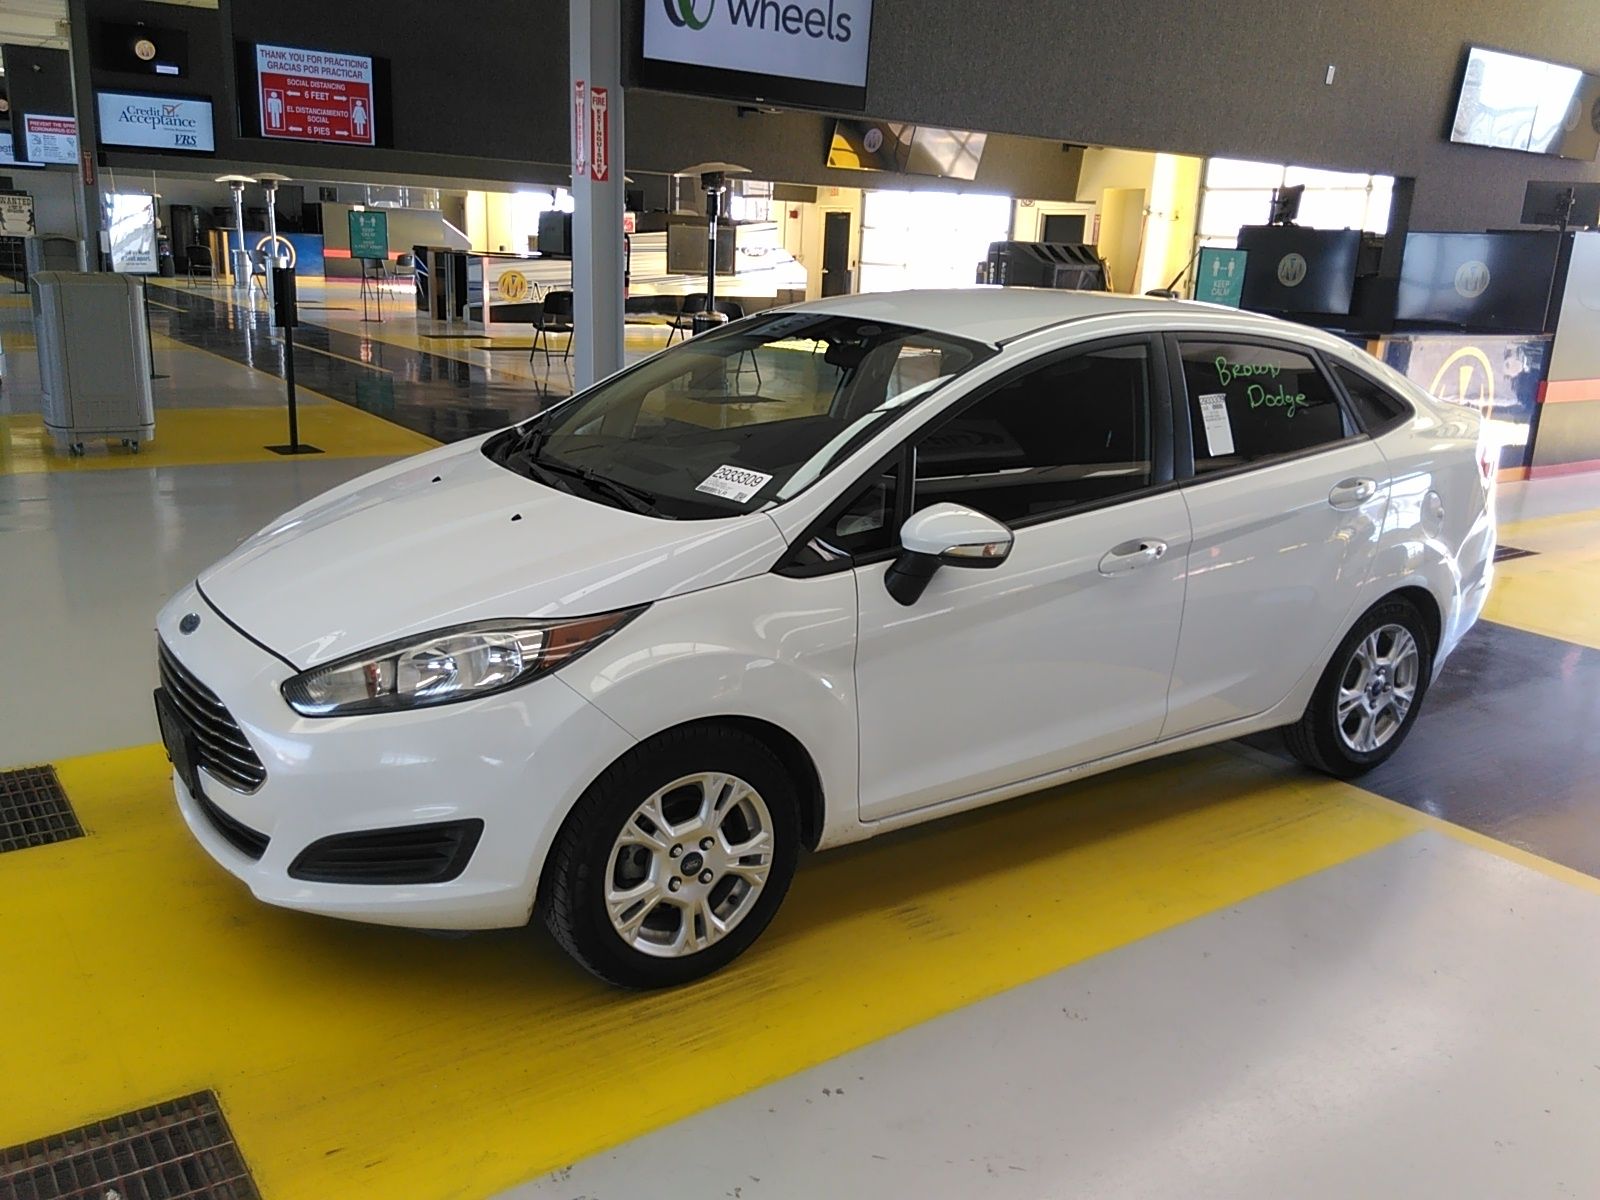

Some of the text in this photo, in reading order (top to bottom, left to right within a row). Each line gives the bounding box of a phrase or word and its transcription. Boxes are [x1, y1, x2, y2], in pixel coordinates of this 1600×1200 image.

[728, 0, 852, 42] wheels
[260, 49, 368, 69] THANK YOU FOR PRACTICING
[267, 61, 363, 79] GRACIAS POR PRACTICAR
[287, 78, 346, 91] SOCIAL DISTANCING
[304, 91, 329, 101] 6 FEET
[592, 95, 606, 106] FIRE
[127, 105, 161, 117] Credit
[287, 105, 349, 118] EL DISTANCIAMIENTO
[118, 110, 197, 130] Acceptance
[307, 115, 329, 124] SOCIAL
[307, 126, 331, 136] 6 PIES
[174, 134, 198, 146] VRS
[1247, 384, 1309, 418] Dodge
[712, 467, 764, 488] 2933309
